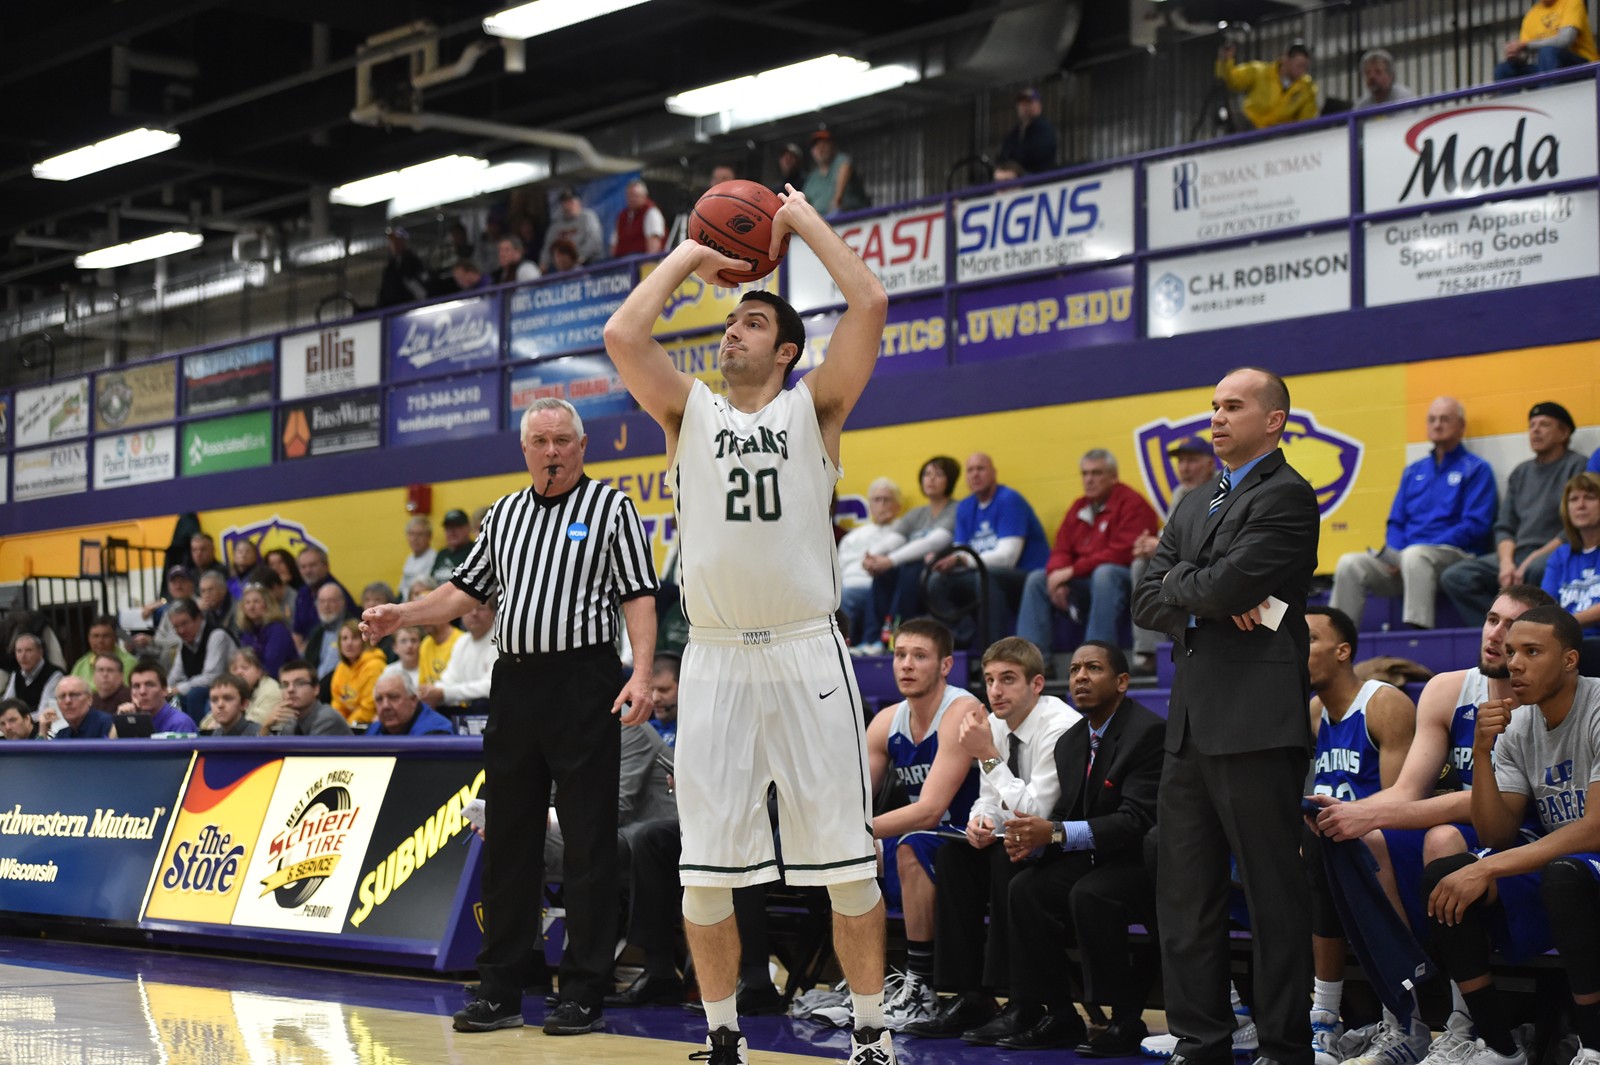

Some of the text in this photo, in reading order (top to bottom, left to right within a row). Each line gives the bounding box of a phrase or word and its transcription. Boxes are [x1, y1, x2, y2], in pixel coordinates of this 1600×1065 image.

[1264, 151, 1322, 178] ROMAN
[1399, 117, 1560, 202] Mada
[958, 182, 1102, 255] SIGNS
[1385, 217, 1459, 246] Custom
[1467, 202, 1547, 234] Apparel
[960, 253, 1001, 276] More
[1004, 245, 1041, 267] than
[1400, 227, 1559, 267] Sporting Goods
[533, 282, 582, 310] COLLEGE
[584, 274, 632, 299] TUITION
[880, 271, 906, 289] han
[1188, 254, 1349, 296] C.H. ROBINSON
[1191, 294, 1266, 313] WORLDWIDE
[306, 329, 355, 375] ellis
[726, 467, 782, 522] 20
[743, 631, 771, 645] IWU
[286, 770, 354, 828] BEST TIRE PRICES
[88, 807, 160, 839] Mutual
[199, 825, 231, 855] The
[268, 807, 360, 864] Schierl
[306, 834, 346, 858] TIRE
[350, 769, 486, 928] SUBWAY
[0, 857, 58, 883] Wisconsin
[163, 841, 245, 893] Store
[296, 857, 333, 878] SERVICE
